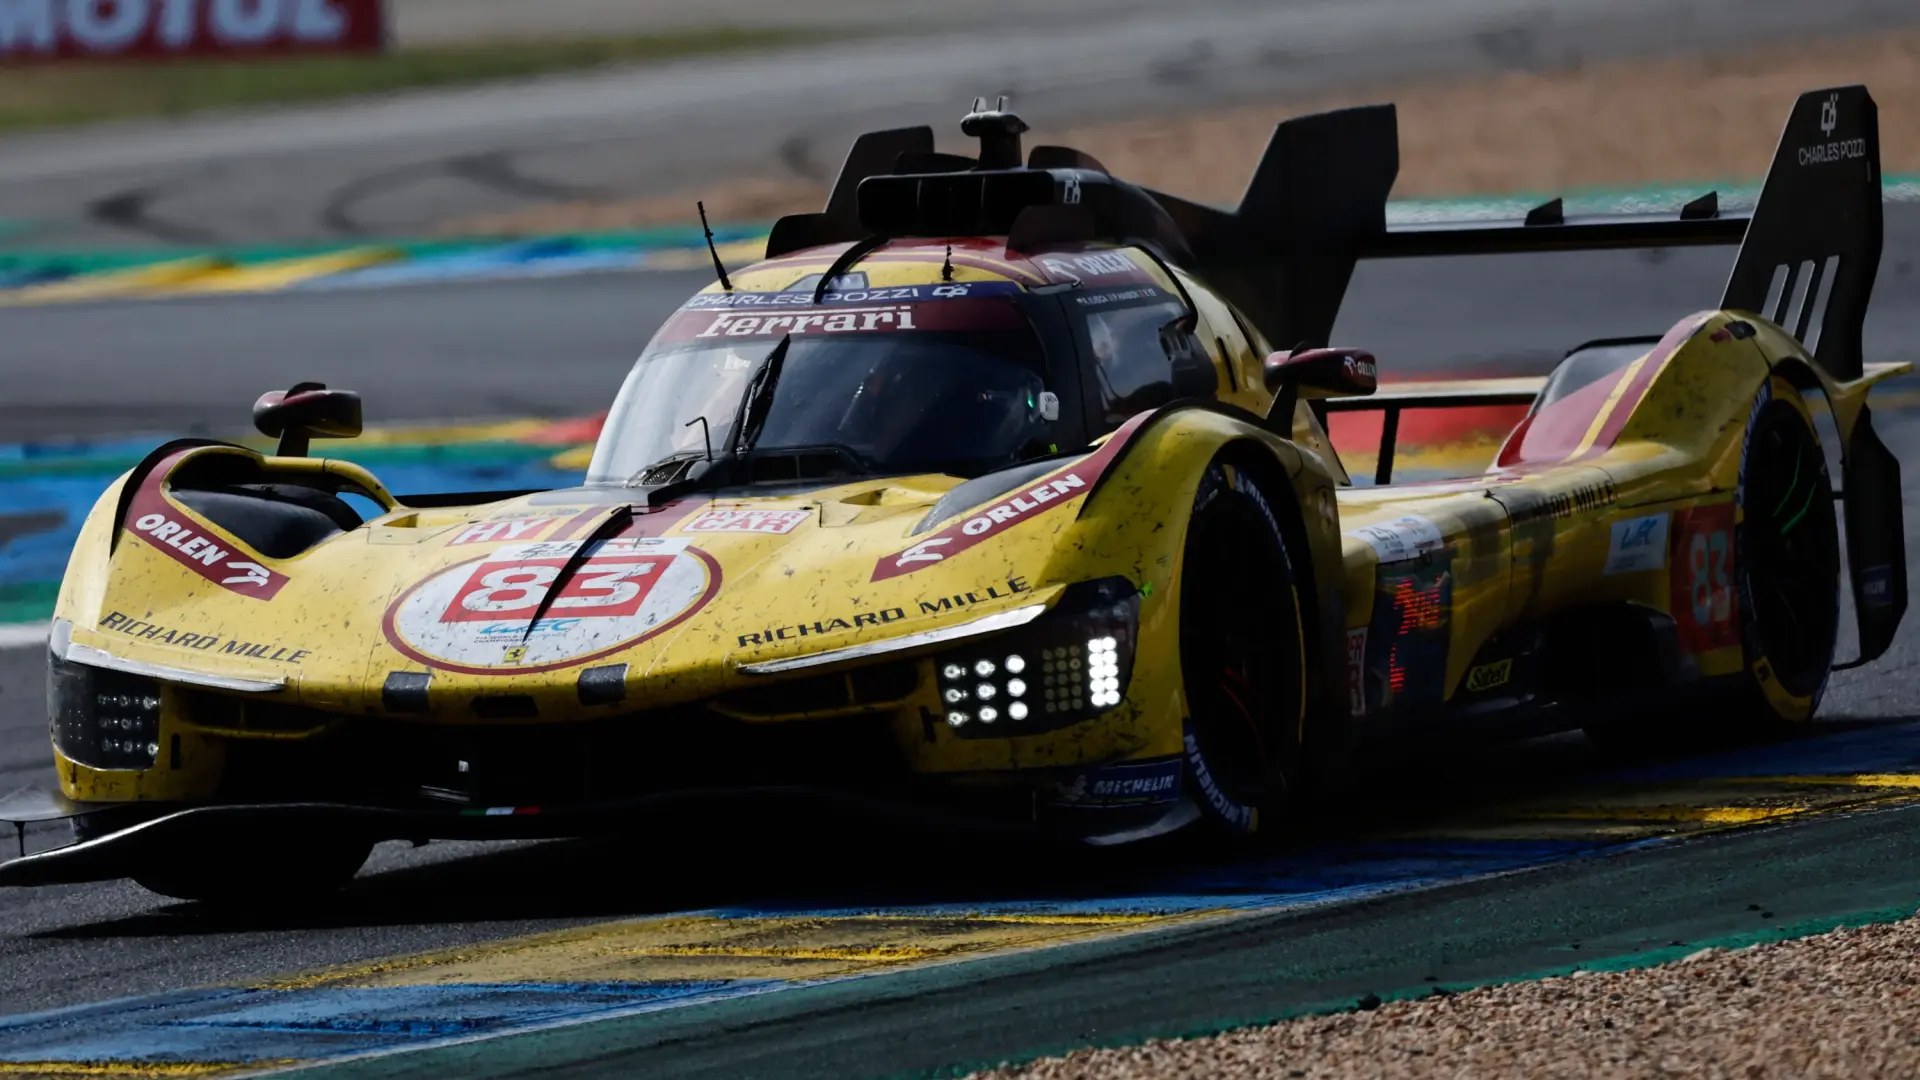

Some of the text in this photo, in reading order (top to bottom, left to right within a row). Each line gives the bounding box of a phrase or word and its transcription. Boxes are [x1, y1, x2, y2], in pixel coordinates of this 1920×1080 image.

[0, 0, 345, 52] OTUL
[1799, 138, 1866, 166] CHARLES POZZI
[1076, 252, 1137, 275] ORLEN
[689, 292, 813, 307] CHARLES
[696, 306, 916, 338] Ferrari
[693, 518, 790, 531] CAR
[962, 474, 1087, 535] ORLEN
[135, 514, 229, 567] ORLEN
[451, 518, 551, 544] HY
[461, 563, 657, 612] 83
[1690, 531, 1731, 627] 83
[738, 576, 1031, 648] RICHARD MILLE
[99, 611, 312, 664] RICHARD MILLE
[1093, 774, 1175, 795] MICHELIN
[1184, 734, 1240, 825] MICHELIN
